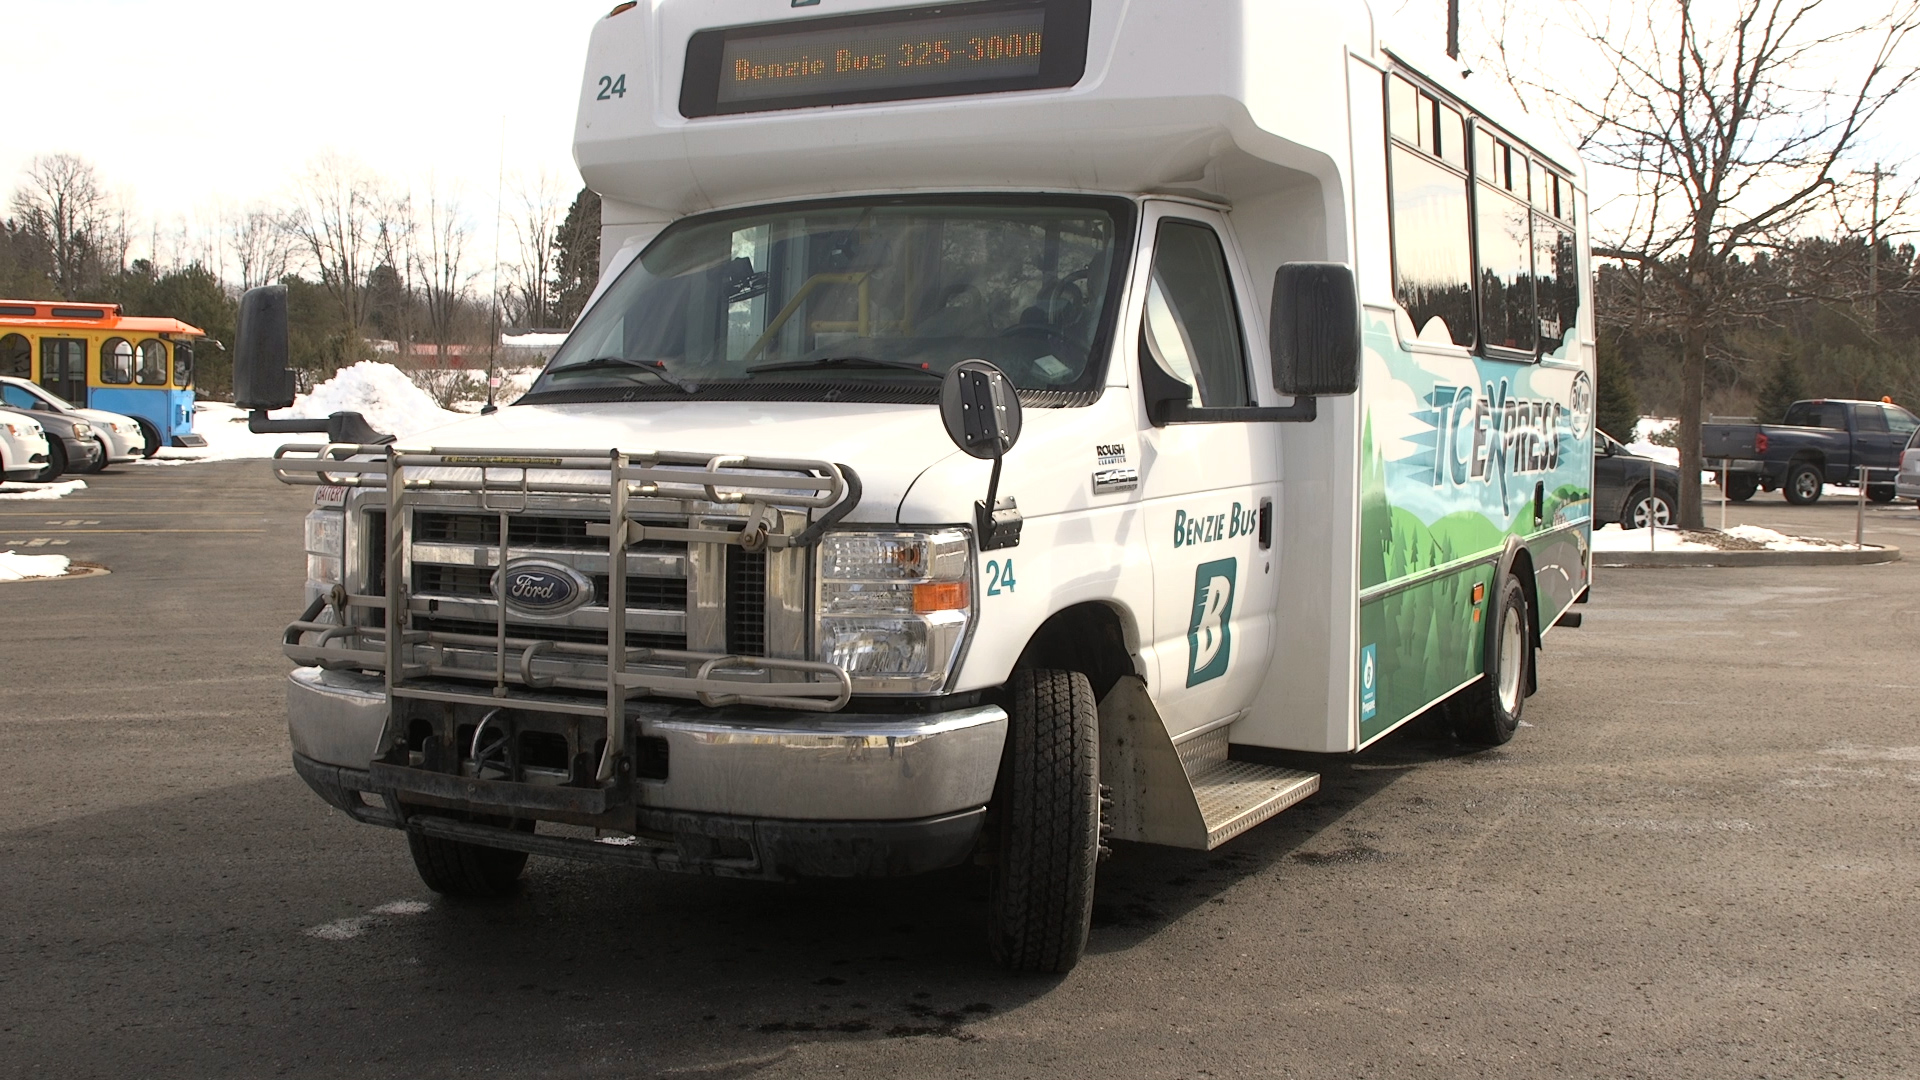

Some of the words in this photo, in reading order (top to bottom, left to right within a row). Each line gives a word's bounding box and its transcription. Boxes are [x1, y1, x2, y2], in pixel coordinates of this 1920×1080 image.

[734, 55, 826, 83] Benzie
[835, 48, 888, 74] Bus
[897, 30, 1043, 68] 325-3000
[596, 73, 628, 101] 24
[1096, 444, 1126, 456] ROUSH
[317, 485, 347, 502] BATTERY
[1174, 509, 1224, 549] BENZIE
[1229, 501, 1258, 539] BUS
[511, 573, 555, 600] Ford
[985, 558, 1017, 598] 24
[1193, 575, 1231, 674] B
